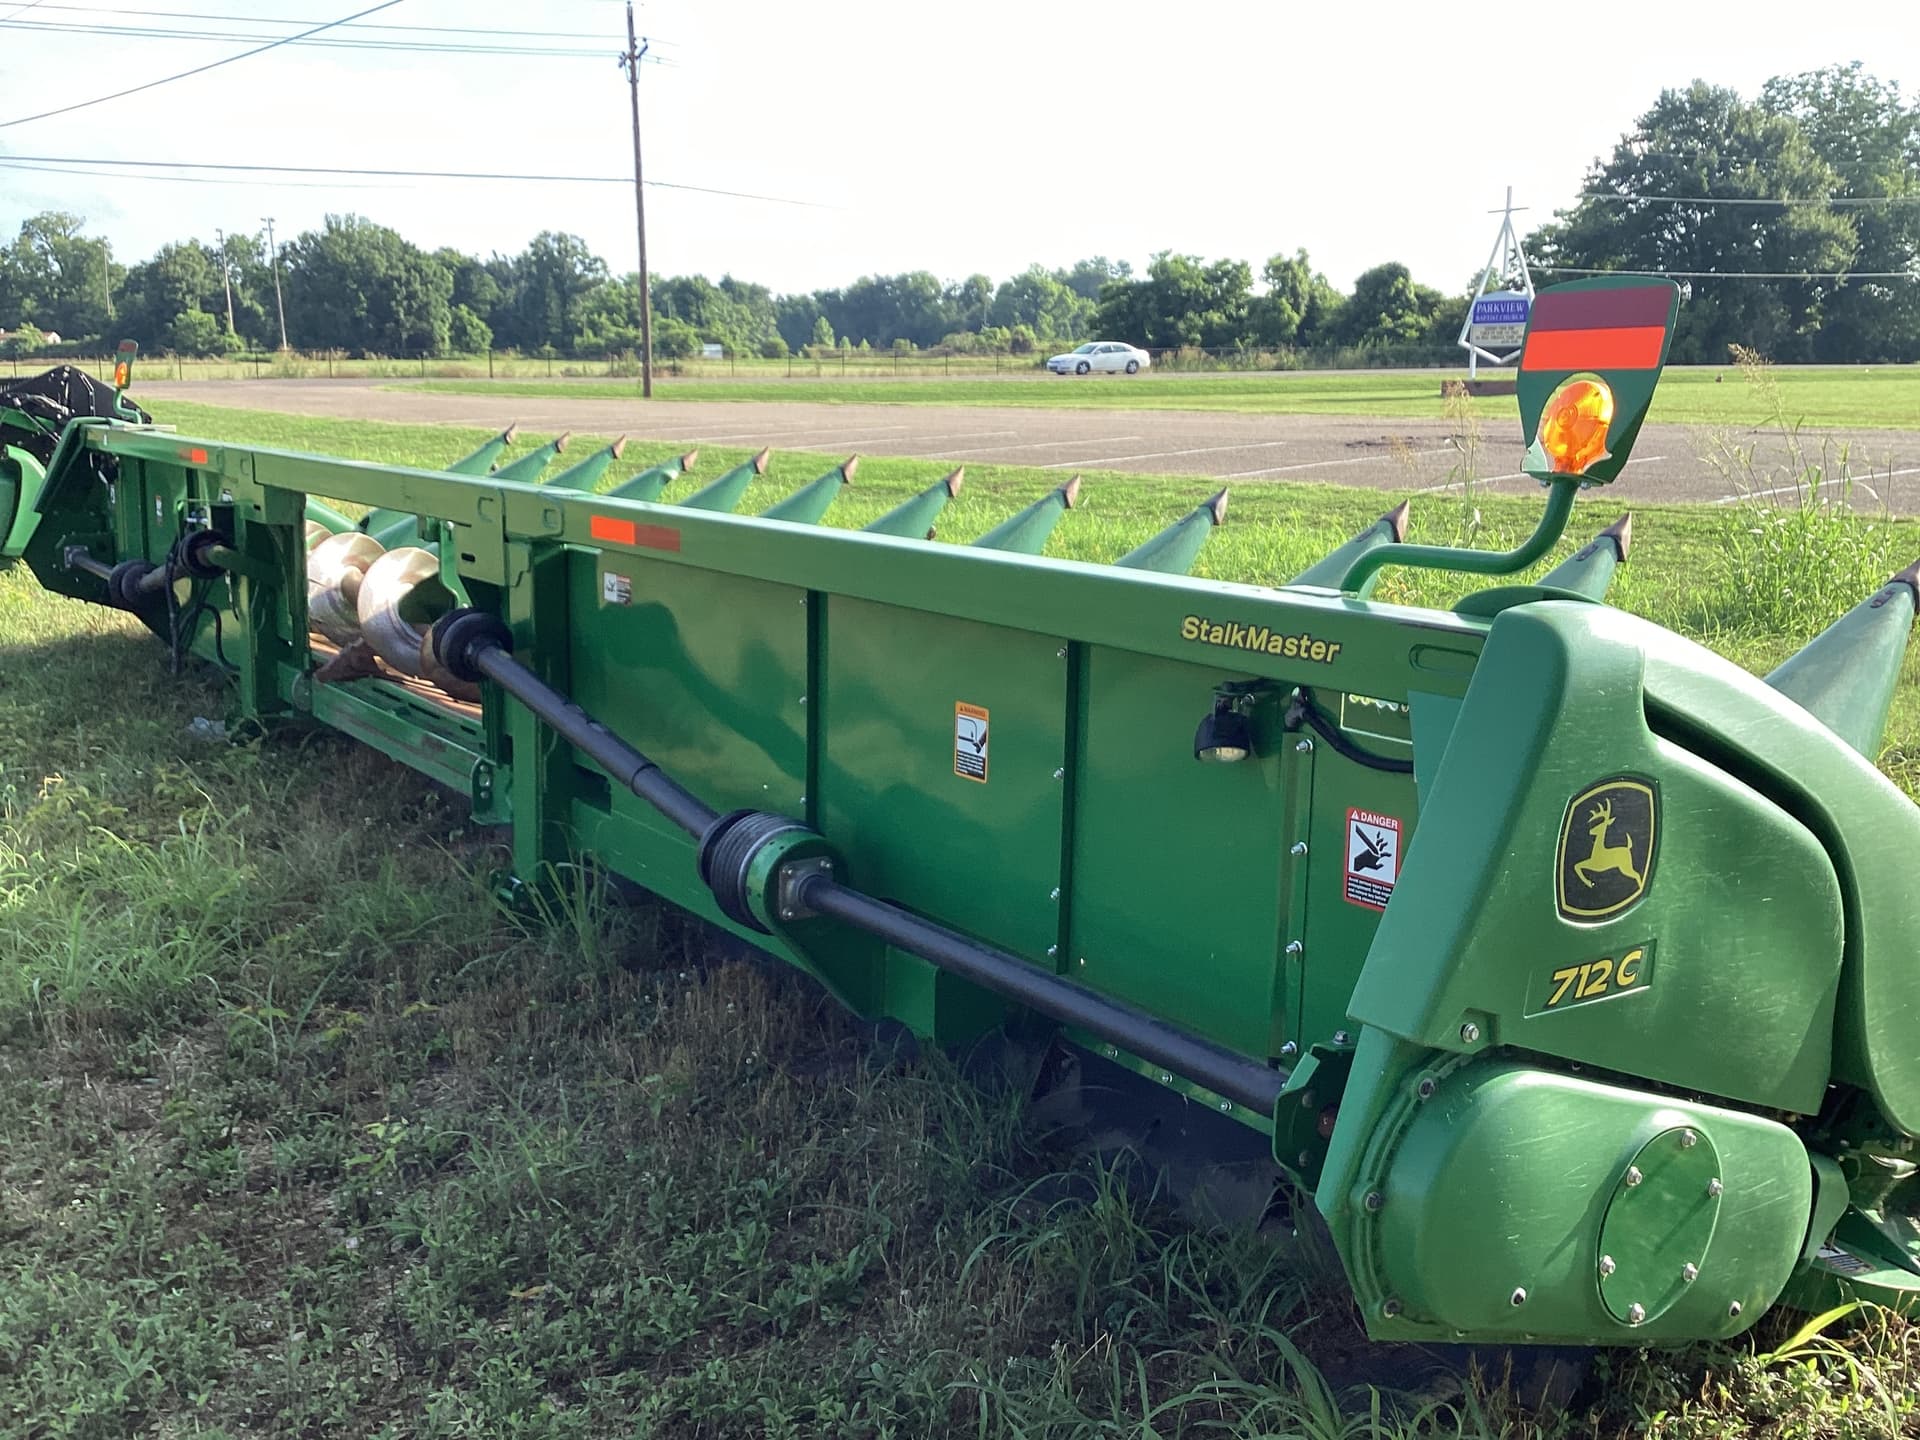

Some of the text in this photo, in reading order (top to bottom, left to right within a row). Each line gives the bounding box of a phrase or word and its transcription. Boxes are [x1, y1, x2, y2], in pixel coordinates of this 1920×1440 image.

[1476, 302, 1525, 313] PARKVIEW
[1181, 615, 1340, 663] StalkMaster
[1360, 812, 1398, 830] DANGER
